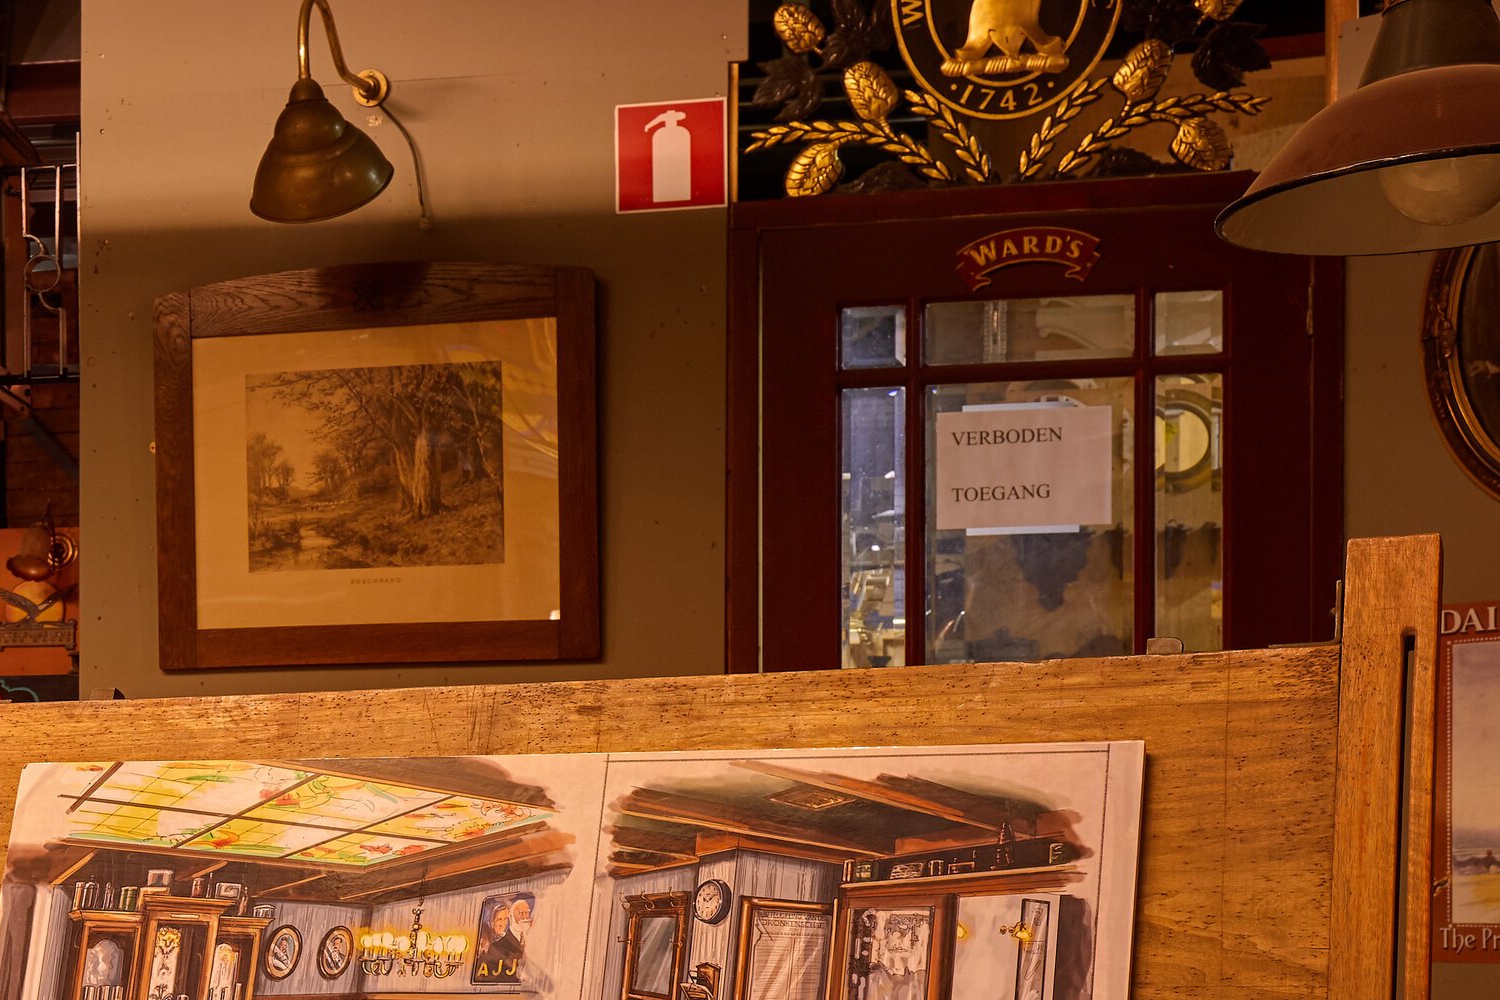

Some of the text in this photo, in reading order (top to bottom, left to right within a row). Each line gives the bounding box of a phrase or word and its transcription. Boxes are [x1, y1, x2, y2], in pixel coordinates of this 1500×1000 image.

[960, 83, 1043, 111] 1742
[970, 235, 1083, 267] WARD'S
[952, 427, 1063, 446] VERBODEN
[952, 484, 1050, 502] TOEGANG
[1439, 927, 1476, 954] The
